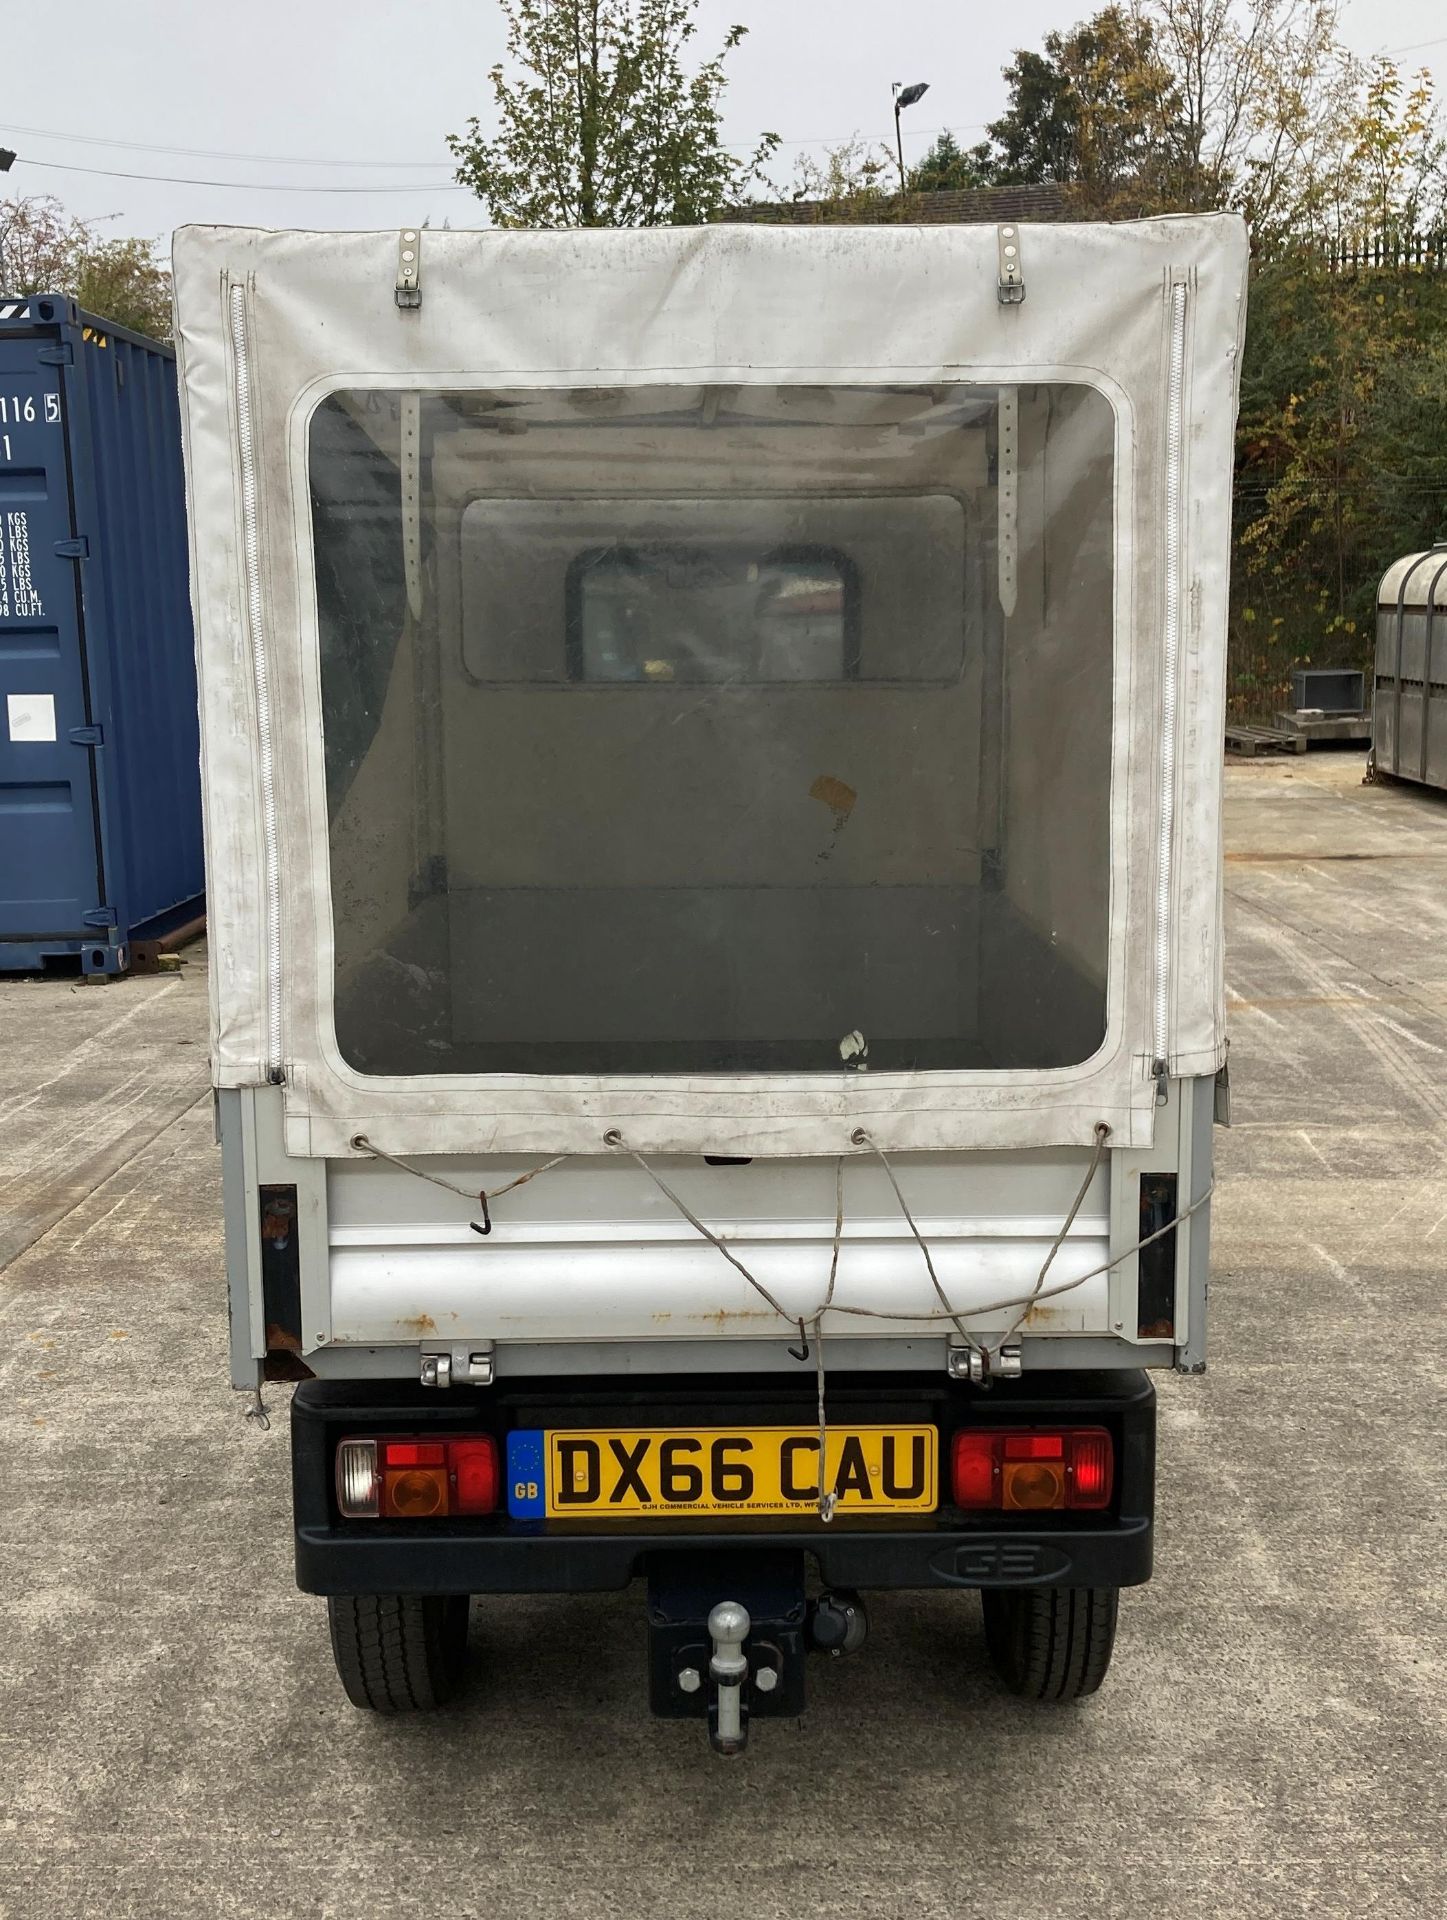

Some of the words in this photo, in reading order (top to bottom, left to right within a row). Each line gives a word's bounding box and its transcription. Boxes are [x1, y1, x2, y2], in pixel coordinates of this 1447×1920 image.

[45, 394, 60, 421] 5
[8, 512, 27, 525] KGS
[9, 526, 28, 538] LBS
[10, 539, 29, 551] KGS
[11, 552, 30, 564] LBS
[12, 565, 31, 577] KGS
[13, 578, 32, 590] LBS
[16, 603, 46, 616] CU.FT.
[556, 1437, 754, 1503] DX66
[780, 1436, 925, 1500] CAU
[514, 1482, 538, 1499] GB
